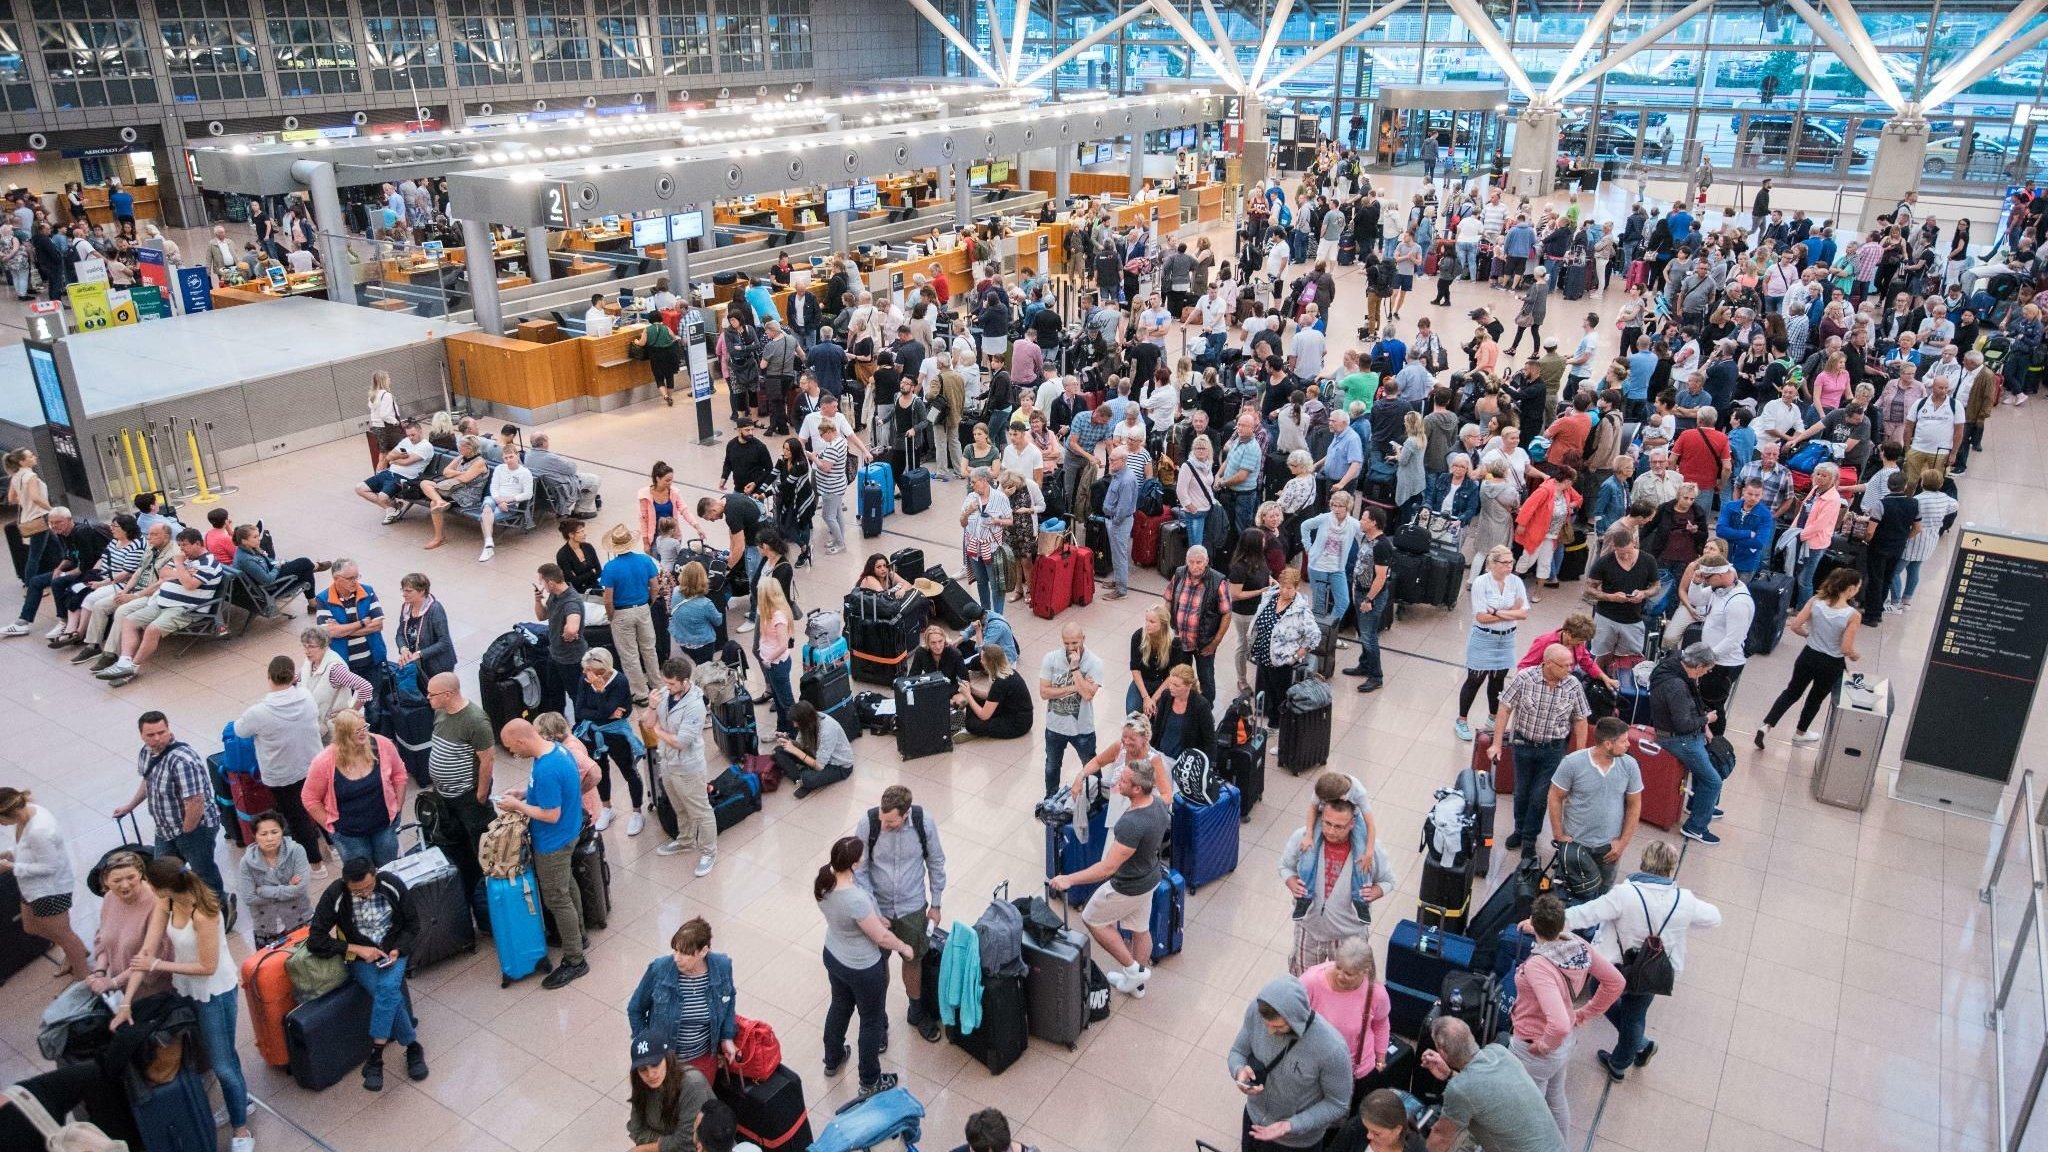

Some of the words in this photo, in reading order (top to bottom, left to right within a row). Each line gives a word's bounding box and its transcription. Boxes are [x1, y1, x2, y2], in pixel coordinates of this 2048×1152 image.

[1230, 98, 1239, 113] 2
[549, 189, 562, 214] 2
[1180, 755, 1195, 795] adidas
